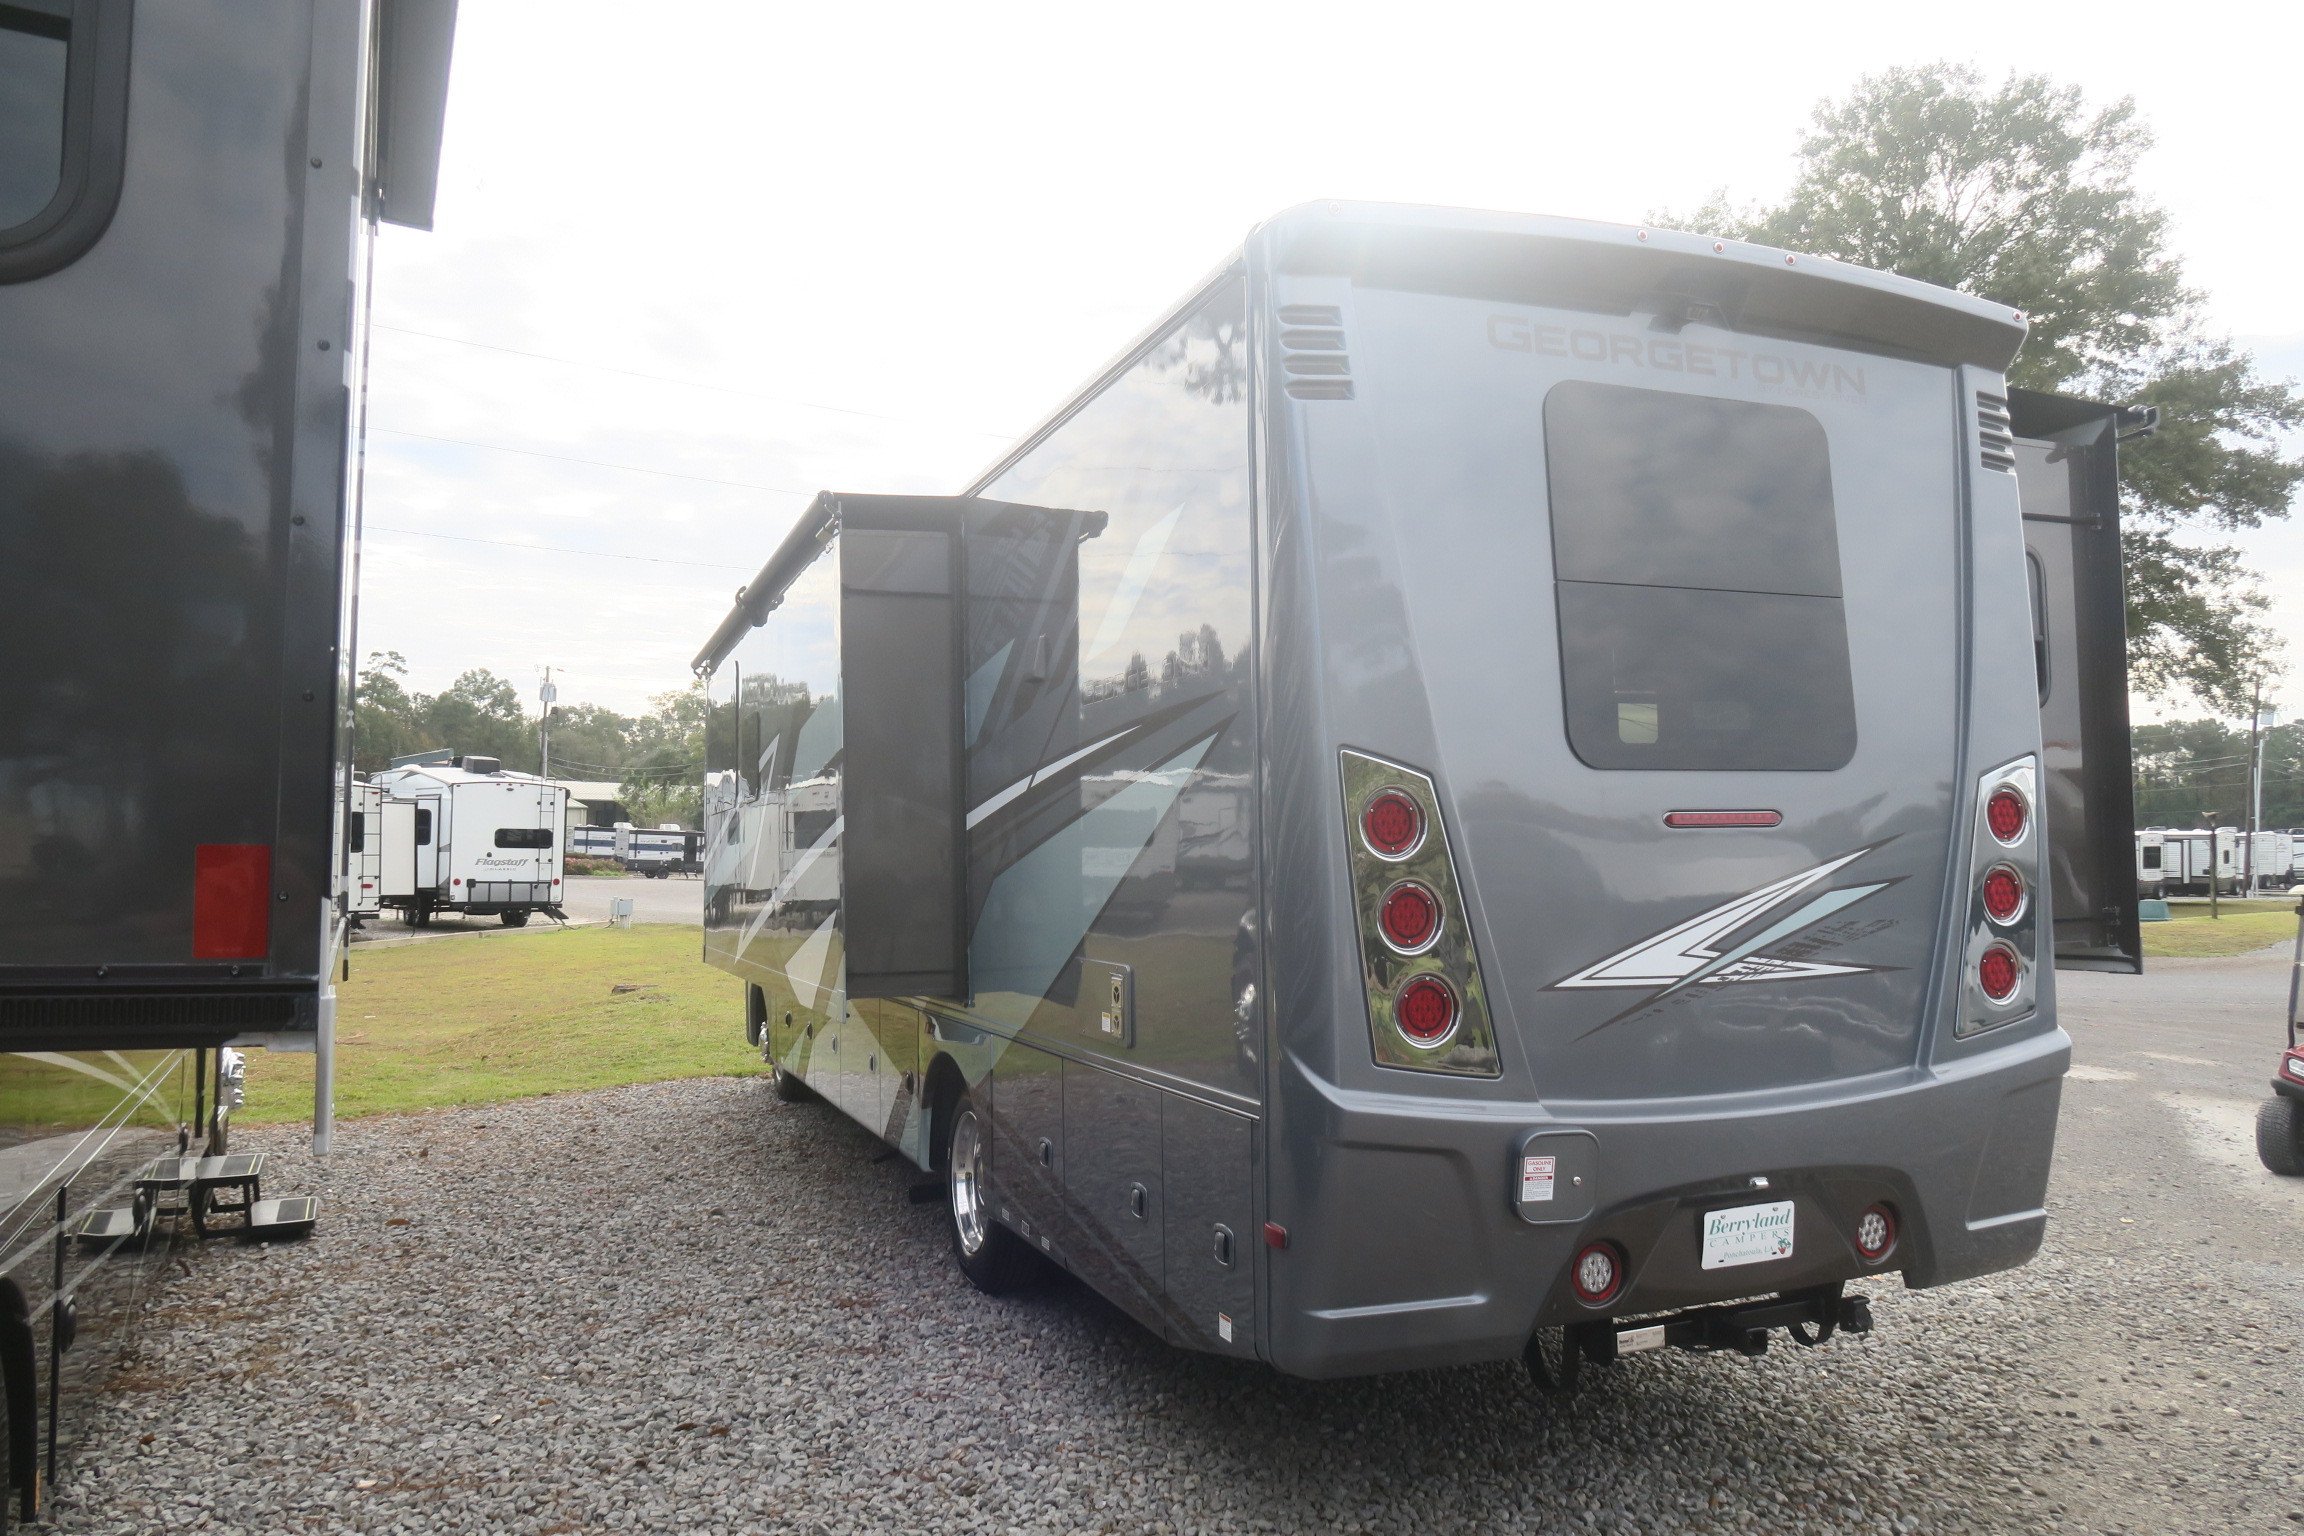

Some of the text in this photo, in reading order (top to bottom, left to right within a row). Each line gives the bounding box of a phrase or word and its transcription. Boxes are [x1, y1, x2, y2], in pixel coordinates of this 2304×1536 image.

[1487, 314, 1866, 395] GEORGETOWN
[475, 858, 530, 866] Flagstaff
[1709, 1209, 1790, 1235] Berryland
[1709, 1229, 1790, 1247] CAMPERS
